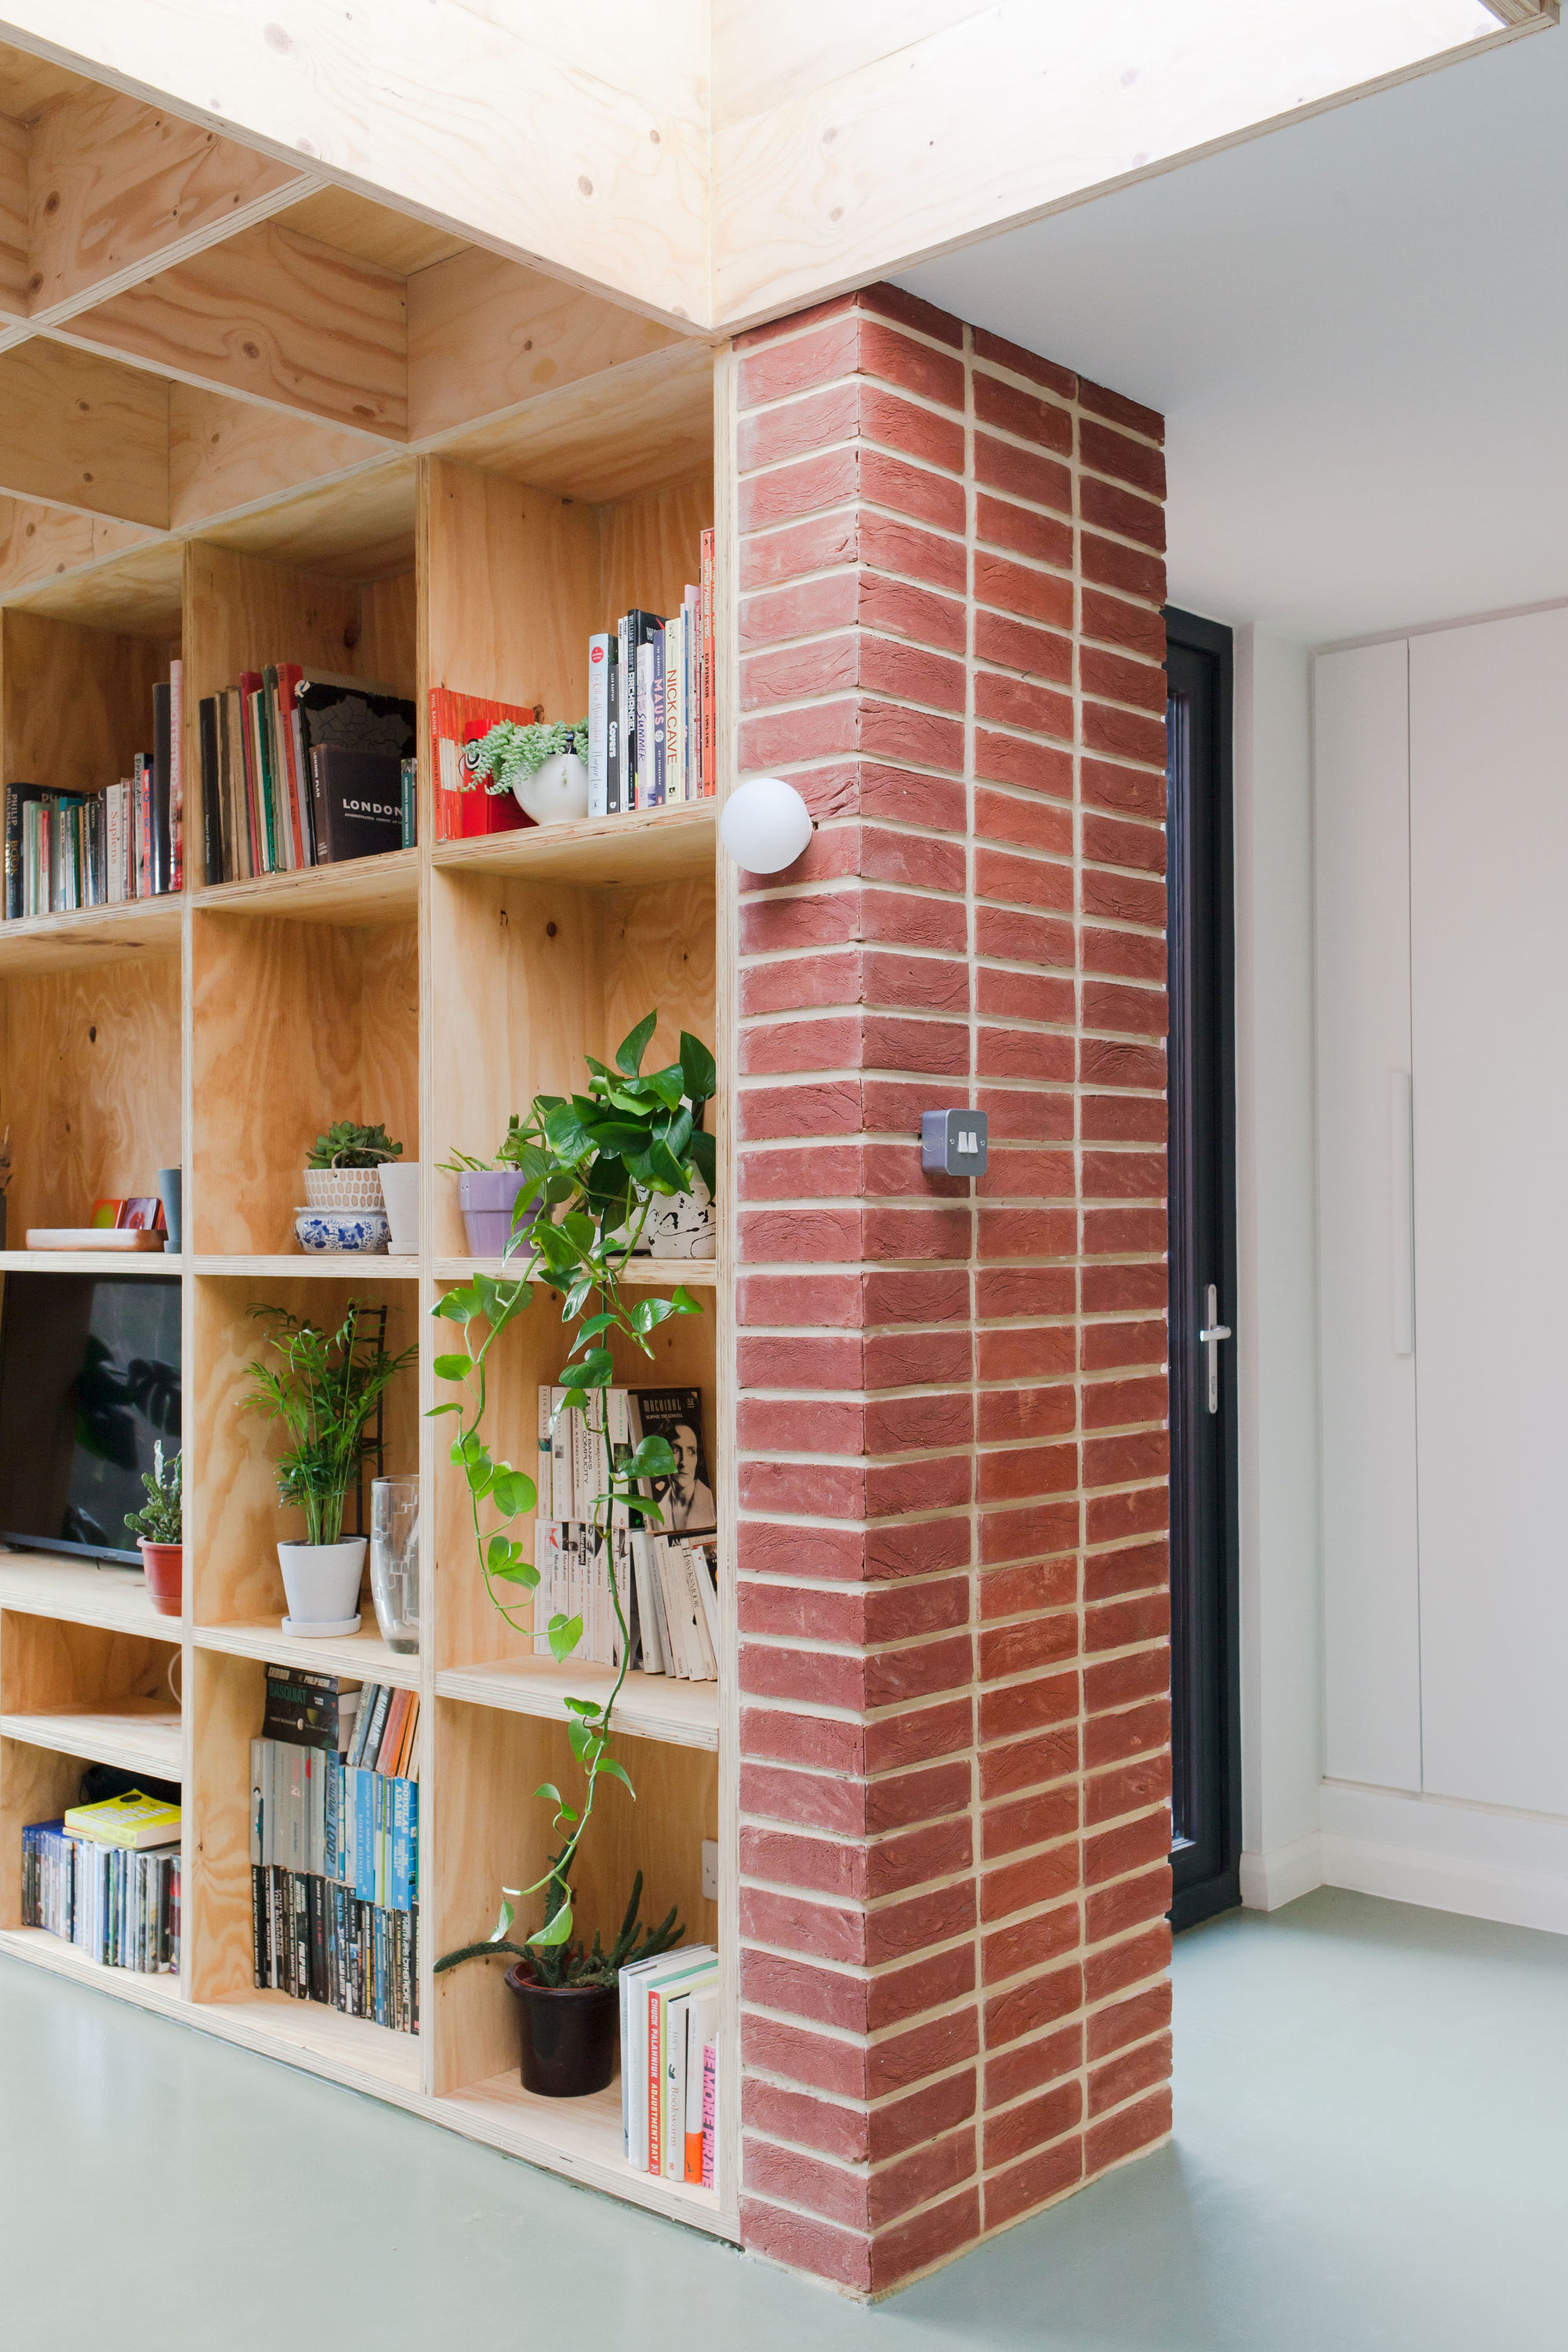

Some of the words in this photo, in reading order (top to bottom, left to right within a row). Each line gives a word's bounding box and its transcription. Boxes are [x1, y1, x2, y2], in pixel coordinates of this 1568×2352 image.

[590, 683, 602, 696] Kill
[654, 679, 665, 725] MAUS
[666, 670, 677, 715] NICK
[609, 721, 618, 758] Covers
[637, 713, 647, 762] SUMMER
[666, 717, 677, 765] CAVE
[435, 773, 439, 782] BY
[590, 751, 602, 776] Harper
[343, 798, 402, 816] LONDON
[109, 811, 118, 864] Sapiens
[643, 1399, 681, 1412] MACHINAL
[682, 1547, 699, 1608] HAWKSMOOR
[372, 1692, 389, 1727] MARTIN
[368, 1723, 382, 1748] AMIS
[326, 1820, 336, 1864] LOOP
[289, 1904, 294, 1915] ON
[691, 2025, 696, 2034] We
[703, 2046, 716, 2068] BE
[702, 2071, 715, 2125] MORE
[670, 2087, 679, 2147] Bookworm
[702, 2126, 714, 2190] PIRATE
